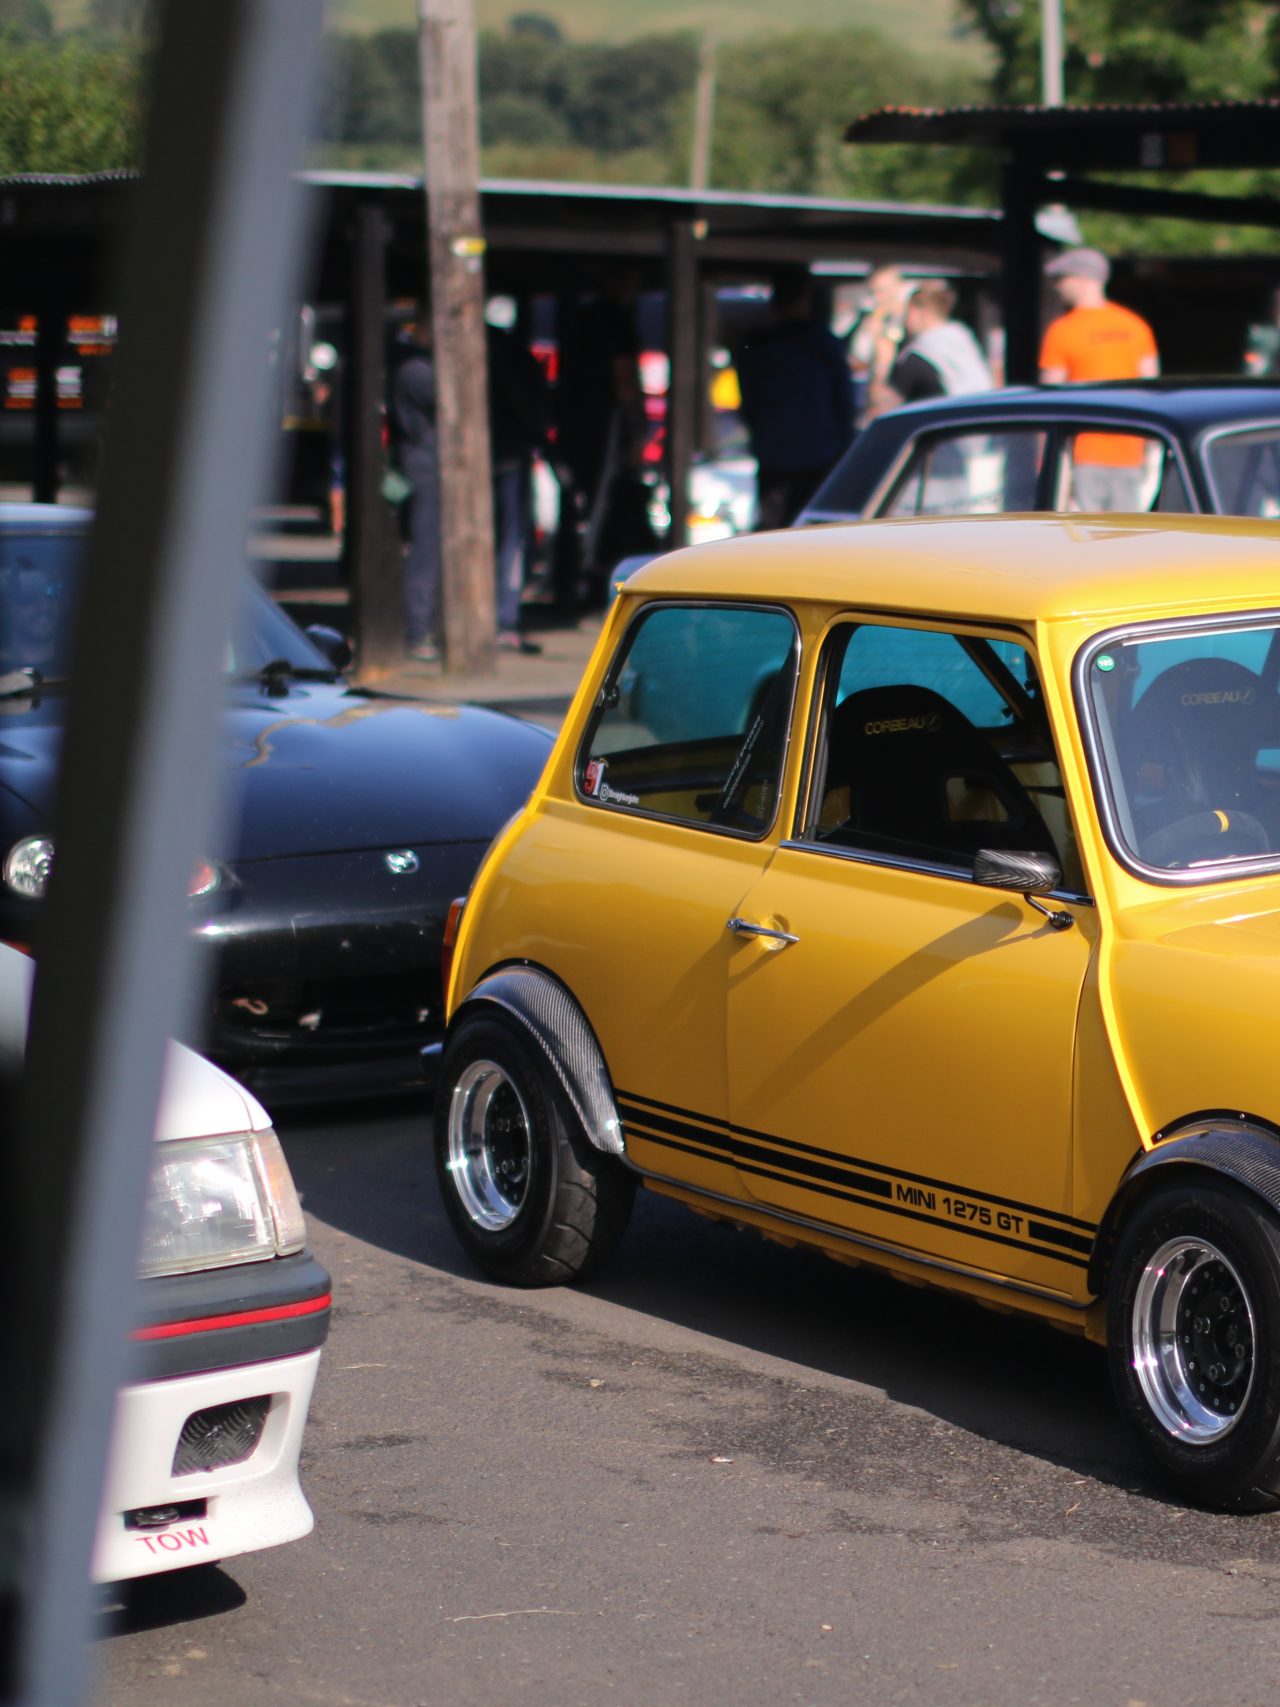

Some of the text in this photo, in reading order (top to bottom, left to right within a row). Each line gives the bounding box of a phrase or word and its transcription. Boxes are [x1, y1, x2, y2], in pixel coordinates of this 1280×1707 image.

[1181, 690, 1240, 706] CORBEAU
[865, 717, 925, 735] CORBEAU
[896, 1183, 1024, 1234] MINI 1275 GT
[136, 1526, 209, 1554] TOW
